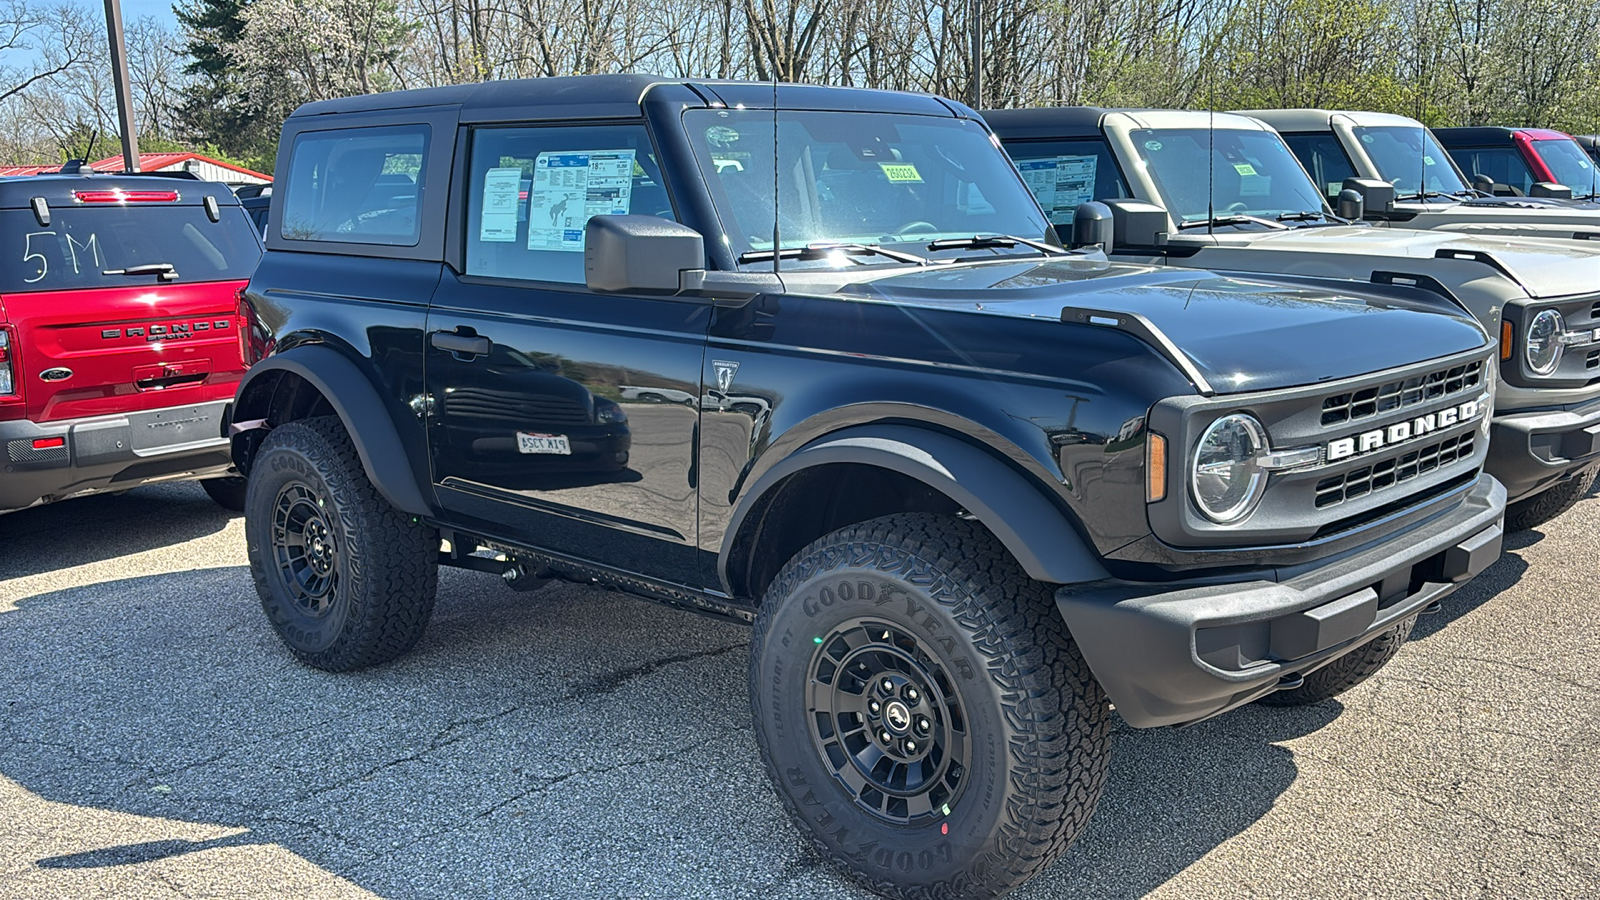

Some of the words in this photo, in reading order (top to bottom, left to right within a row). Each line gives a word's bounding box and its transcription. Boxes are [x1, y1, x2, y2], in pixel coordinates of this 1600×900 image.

[101, 320, 229, 339] BRONCO
[146, 332, 194, 342] SPORT
[1327, 400, 1478, 461] BRONCO
[772, 658, 785, 740] TERRITORY
